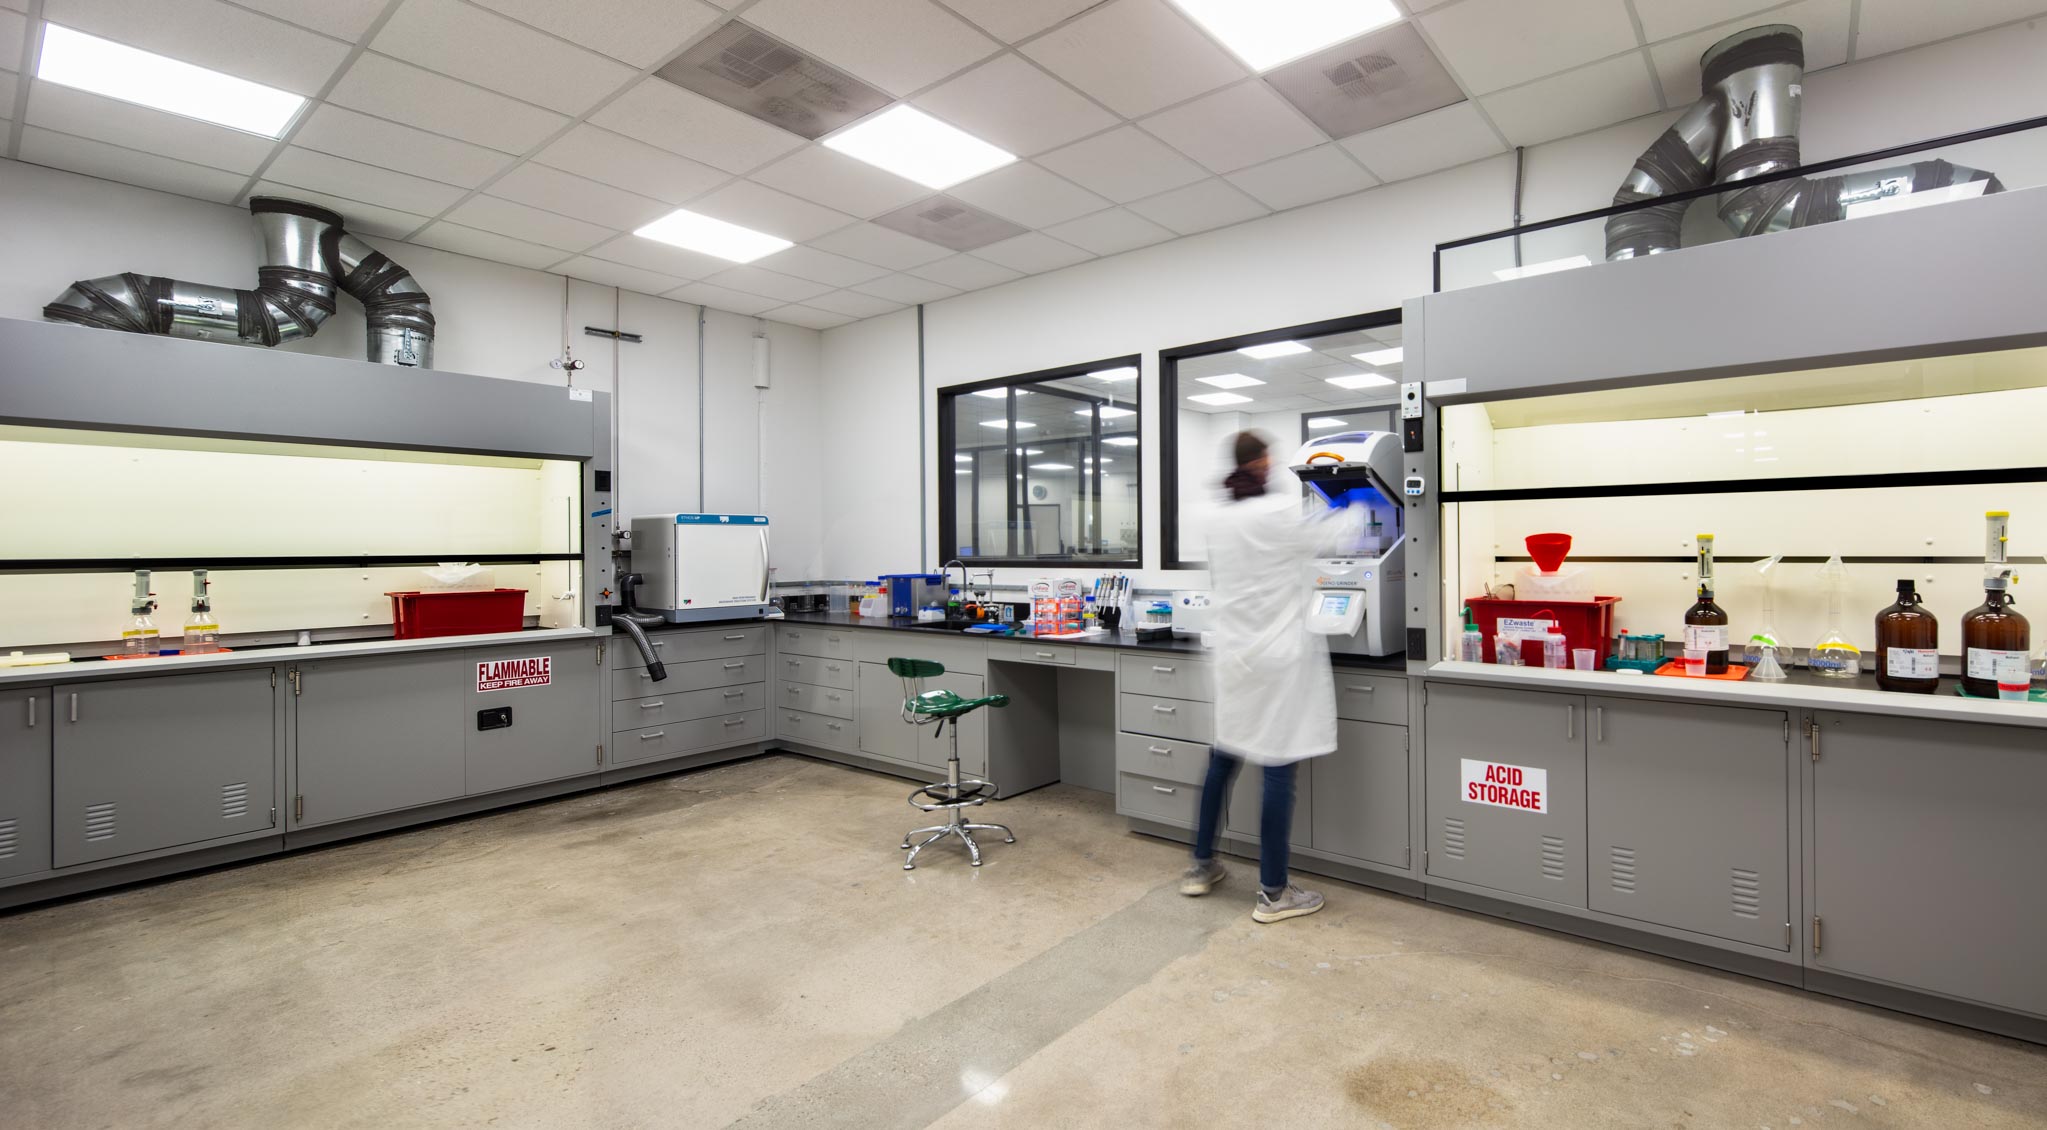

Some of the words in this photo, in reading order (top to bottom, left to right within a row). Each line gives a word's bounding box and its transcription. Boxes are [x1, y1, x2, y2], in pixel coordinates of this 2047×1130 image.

[1503, 619, 1535, 627] EZwaste
[479, 658, 550, 681] FLAMMABLE
[504, 679, 523, 687] FIRE
[524, 676, 549, 685] AWAY
[1485, 764, 1523, 786] ACID
[1468, 782, 1541, 809] STORAGE
